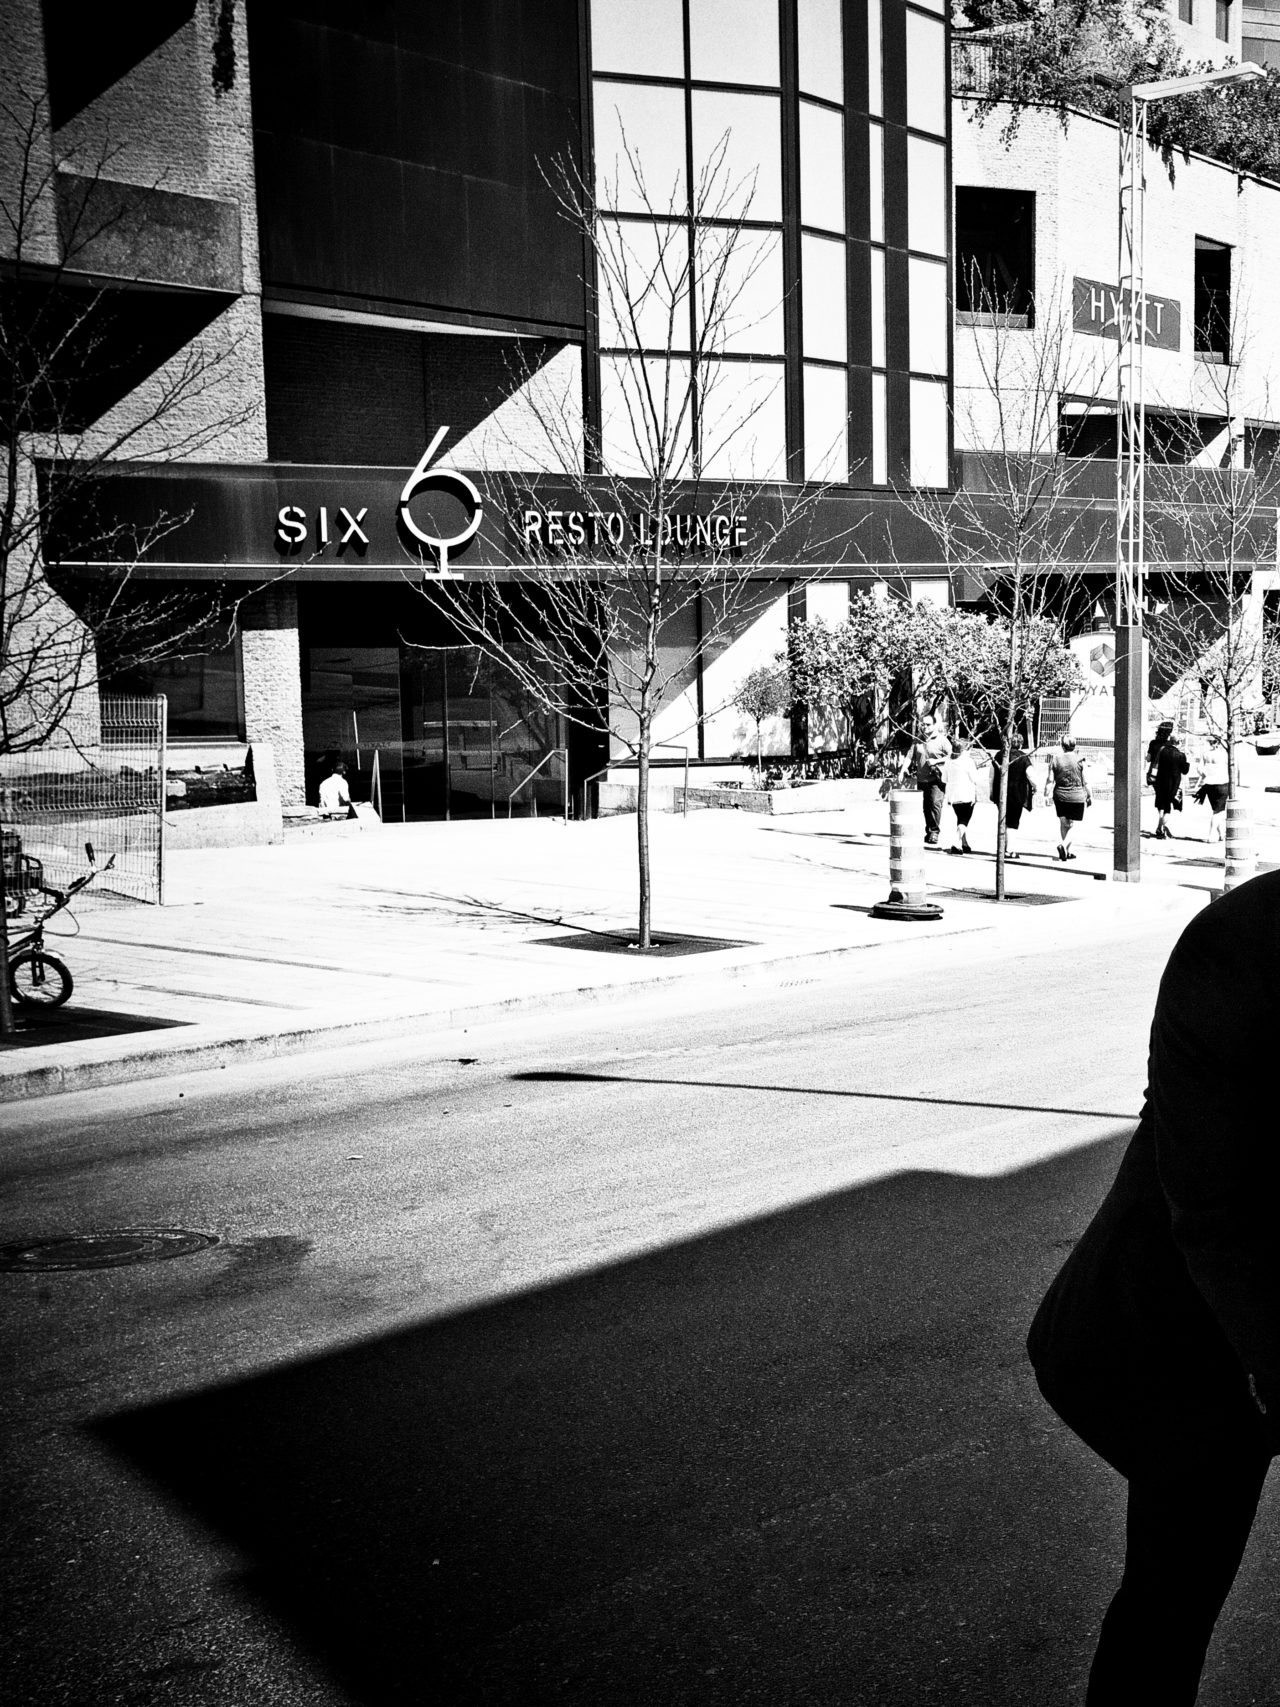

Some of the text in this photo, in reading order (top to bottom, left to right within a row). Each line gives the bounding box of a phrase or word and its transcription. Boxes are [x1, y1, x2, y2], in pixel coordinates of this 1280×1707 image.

[277, 505, 369, 543] SIX
[525, 510, 625, 546] RESTO
[639, 512, 748, 547] LOUNGE
